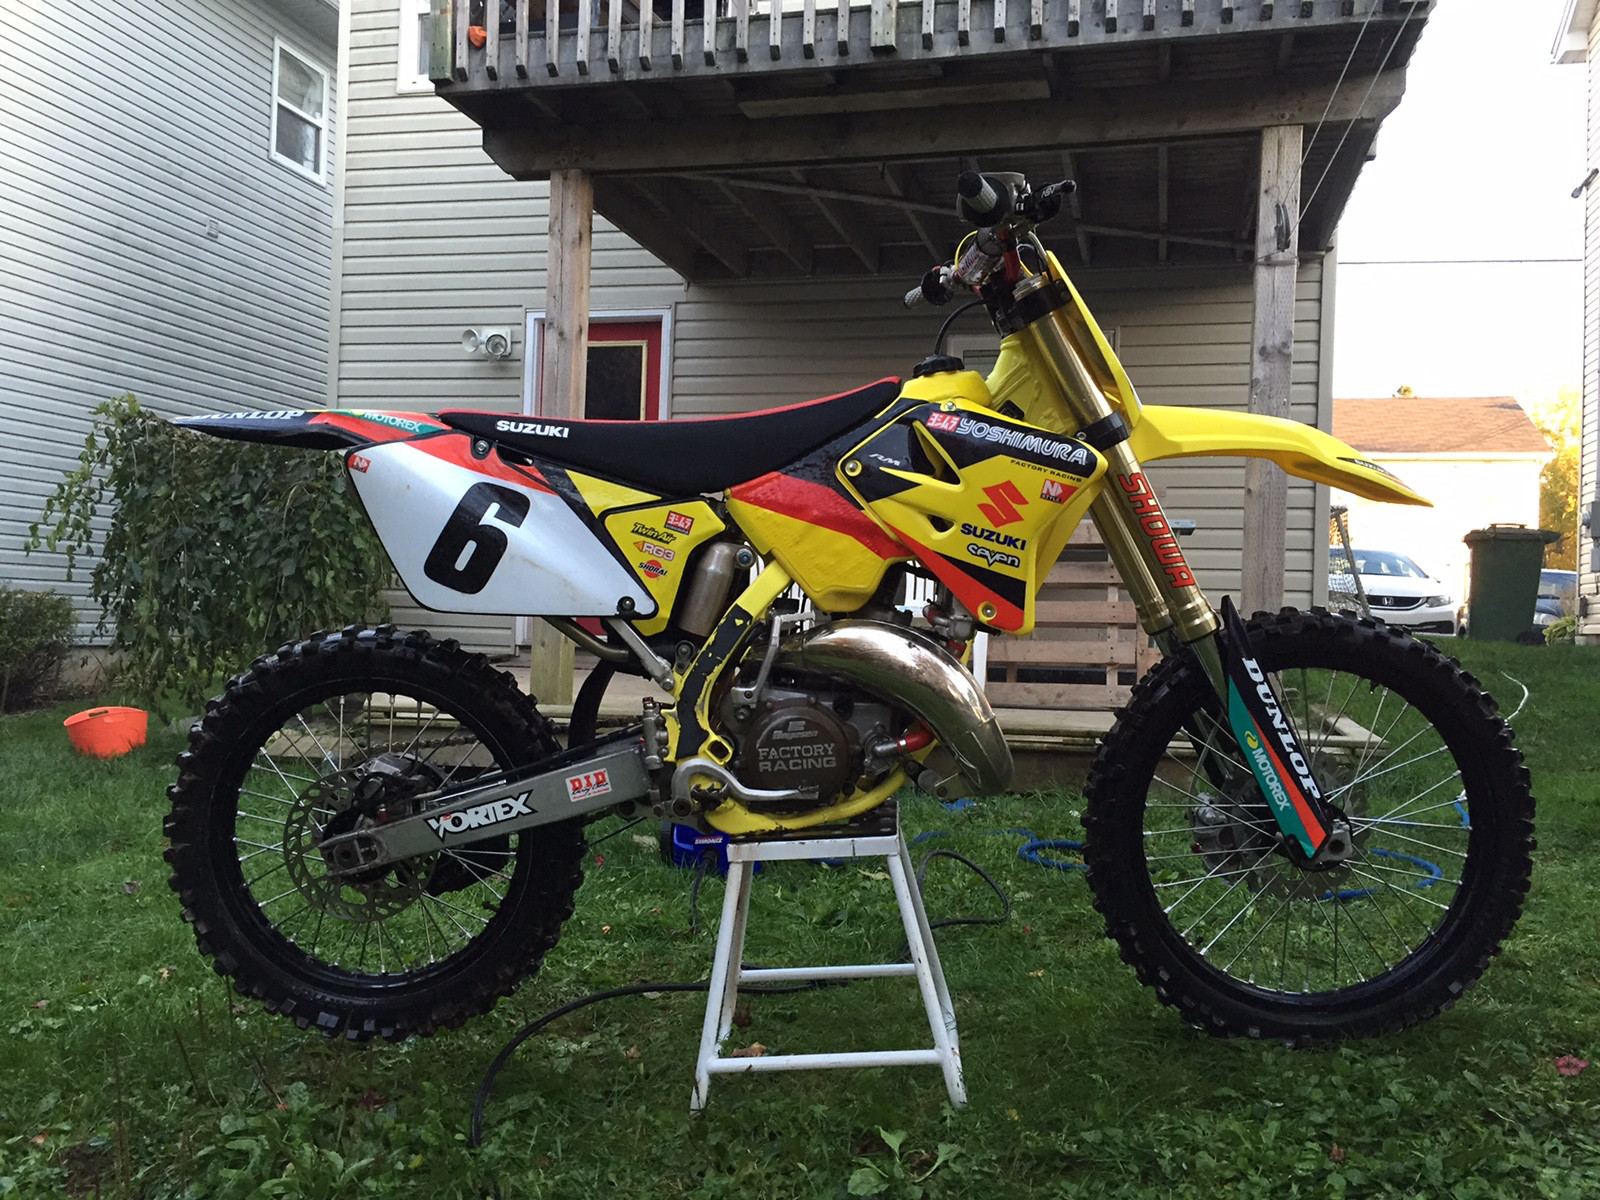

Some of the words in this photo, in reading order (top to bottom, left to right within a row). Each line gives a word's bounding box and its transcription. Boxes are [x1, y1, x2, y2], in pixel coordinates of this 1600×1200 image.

[364, 412, 422, 432] MOTOREX
[496, 420, 569, 438] SUZUKI
[956, 418, 1088, 466] YOSHIMURA
[1010, 459, 1048, 473] FACTORY
[1049, 471, 1082, 483] RACING
[1041, 493, 1061, 503] STYLE
[423, 481, 531, 595] 6
[631, 522, 660, 540] Twin
[658, 531, 677, 544] Air
[960, 523, 1027, 550] SUZUKI
[1117, 472, 1196, 588] SHOWA
[642, 542, 675, 561] RG3
[638, 562, 668, 576] SHORAI
[1242, 656, 1321, 800] DUNLOP
[758, 743, 835, 760] FACTORY
[759, 757, 837, 772] RACING
[1252, 746, 1290, 812] MOTOREX
[426, 791, 534, 840] VORTEX
[694, 836, 724, 845] SIMONIZ
